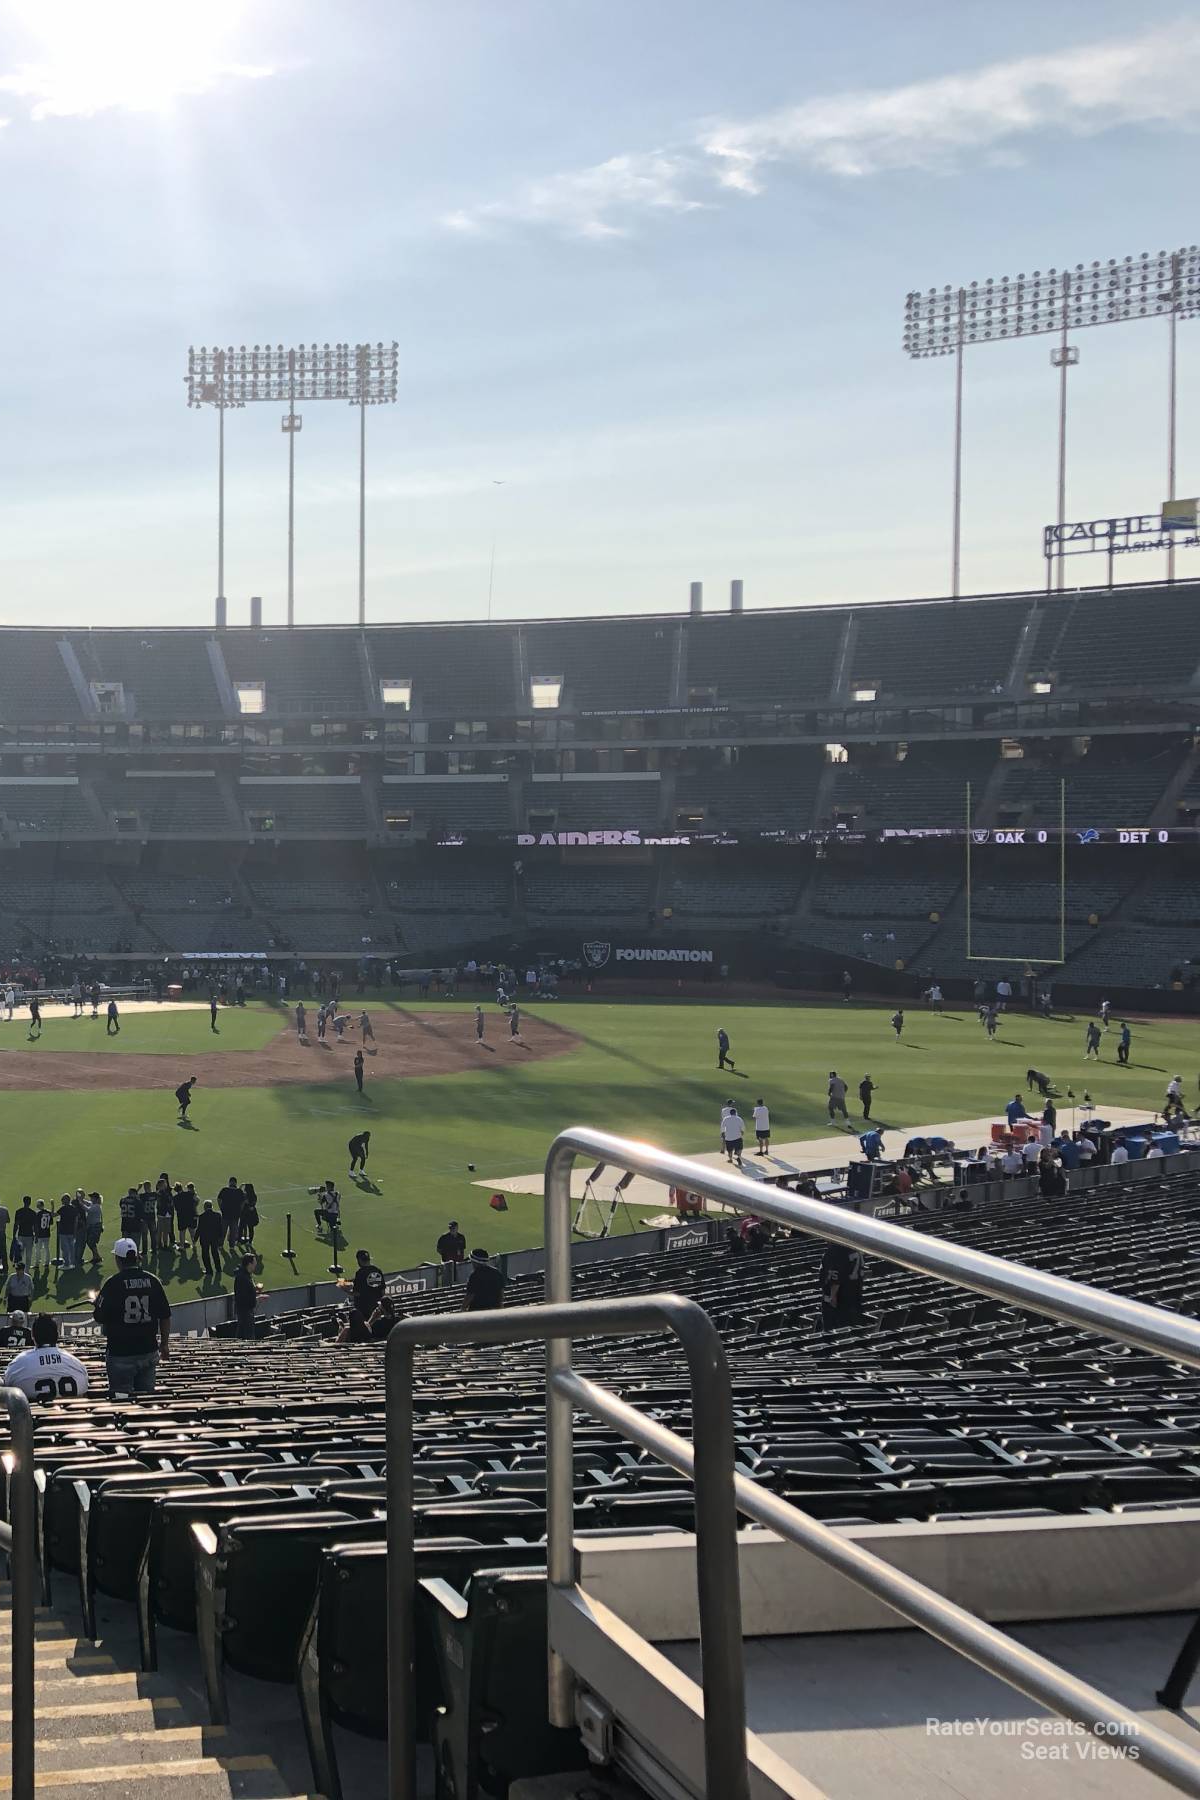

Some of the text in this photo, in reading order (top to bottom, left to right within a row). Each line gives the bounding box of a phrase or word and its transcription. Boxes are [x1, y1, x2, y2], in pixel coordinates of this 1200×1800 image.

[995, 830, 1048, 844] OAK 0
[1119, 830, 1169, 844] DET 0
[615, 948, 714, 962] FOUNDATION
[39, 1353, 62, 1366] BUSH
